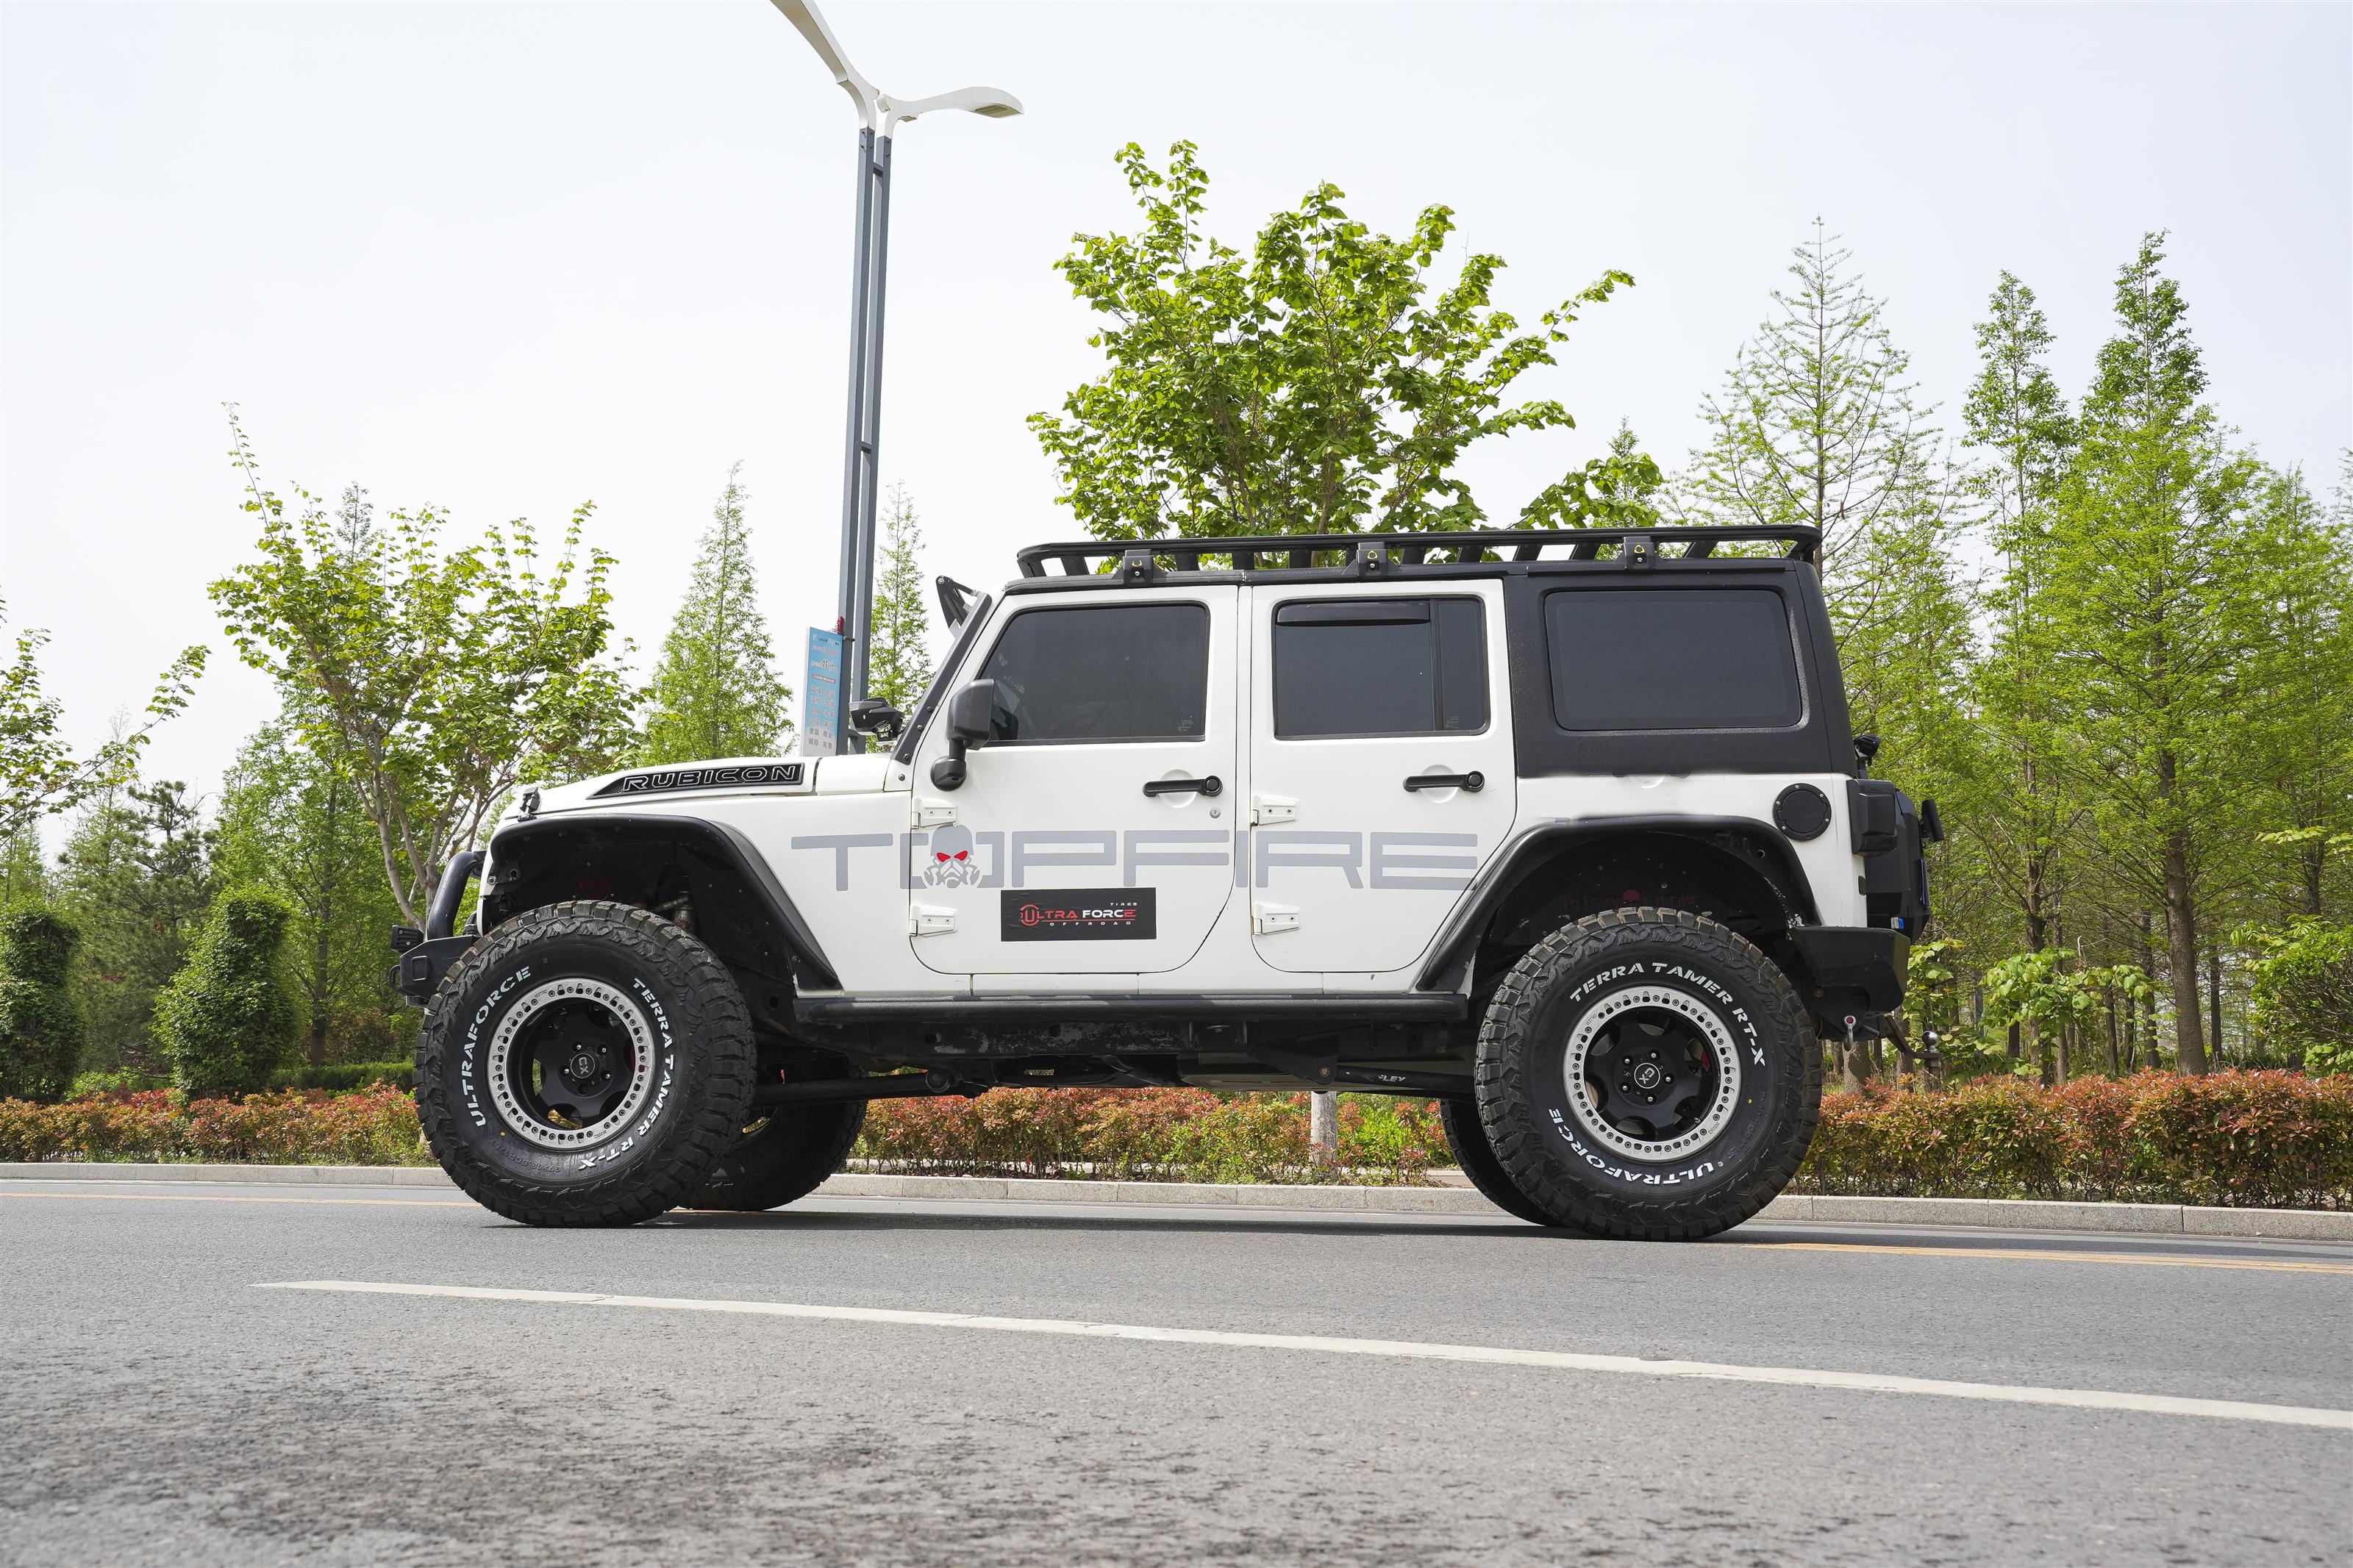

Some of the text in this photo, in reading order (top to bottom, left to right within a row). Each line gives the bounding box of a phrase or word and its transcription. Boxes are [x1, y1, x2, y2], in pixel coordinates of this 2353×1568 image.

[624, 765, 796, 792] RUBICON
[1024, 909, 1137, 923] ULTRA FORCE
[461, 965, 531, 1127] ULTRAFORCE
[1569, 962, 1766, 1067] TERRA TAMER RT-X
[578, 977, 675, 1171] TERRA TAMER RT-X
[1549, 1108, 1715, 1185] ULTRAFORCE
